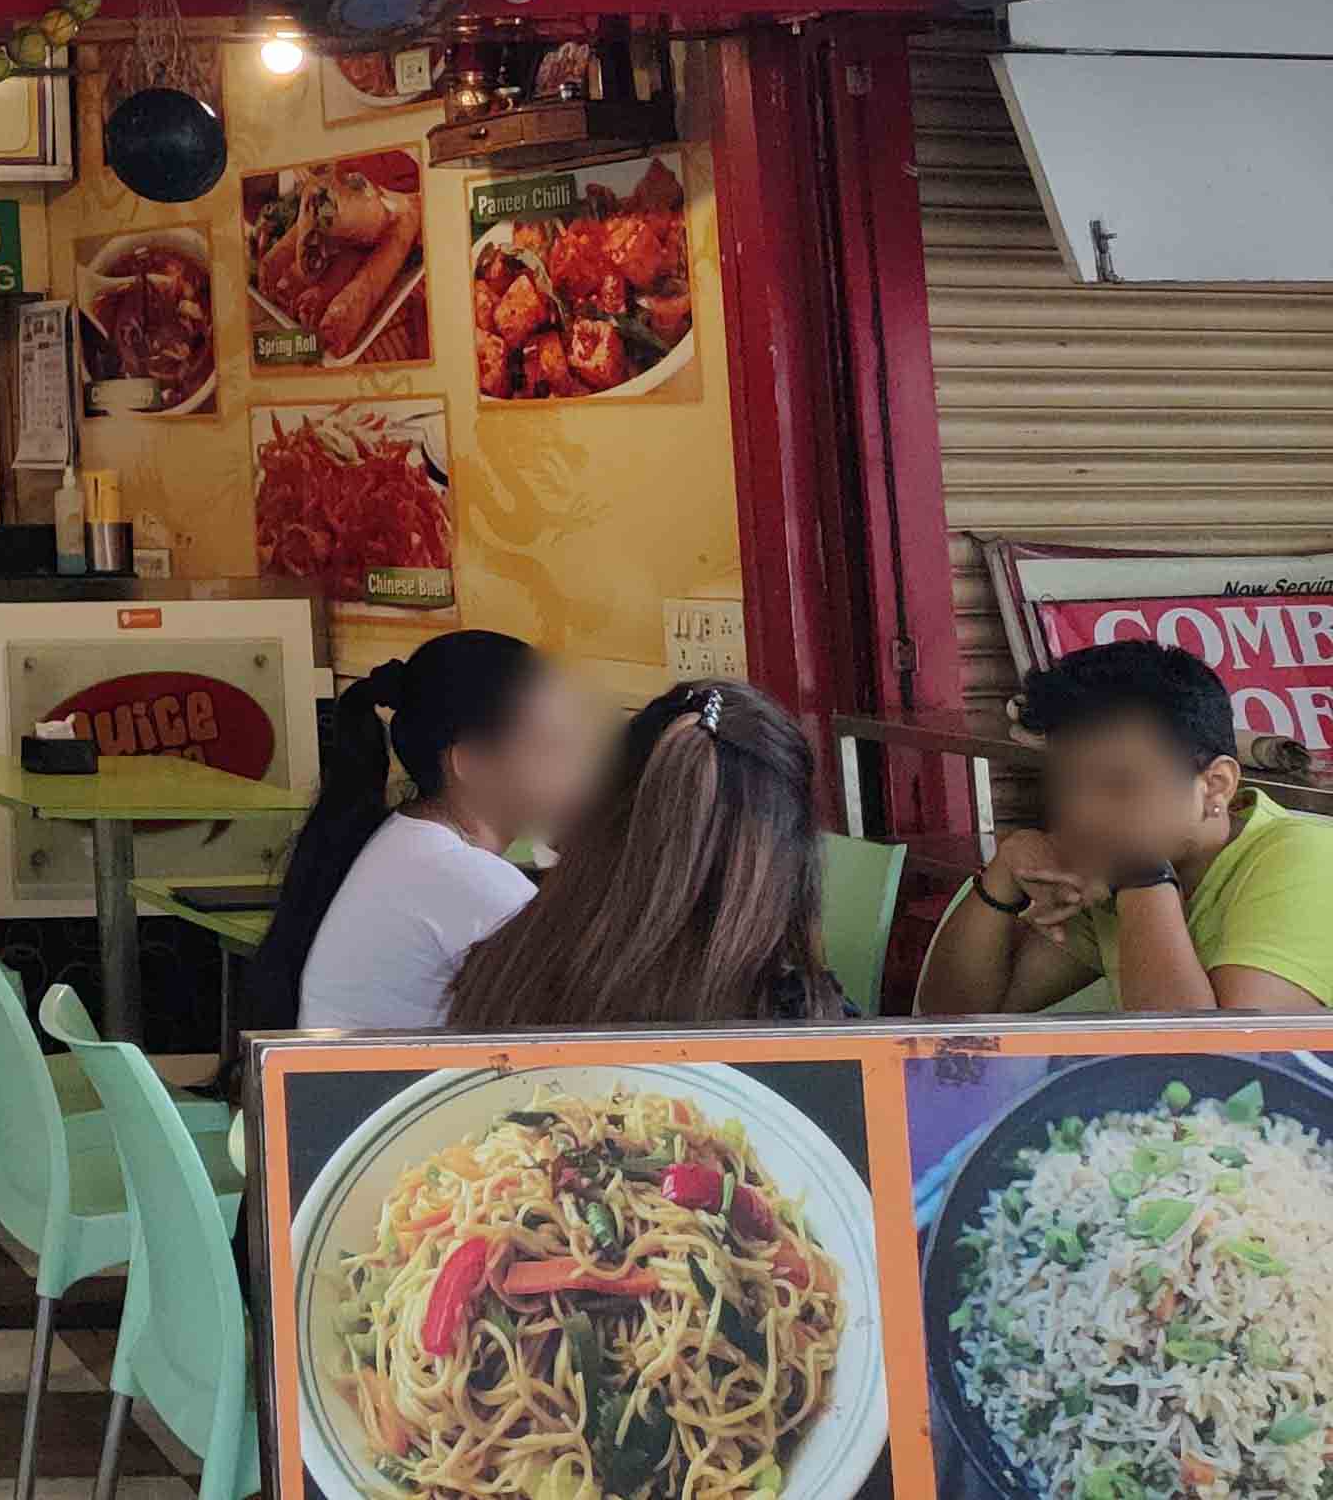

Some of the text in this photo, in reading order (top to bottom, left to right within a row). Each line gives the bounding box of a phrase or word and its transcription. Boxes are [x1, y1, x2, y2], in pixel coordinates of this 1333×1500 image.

[478, 184, 571, 216] Paneer Chilli
[1222, 581, 1268, 596] Now
